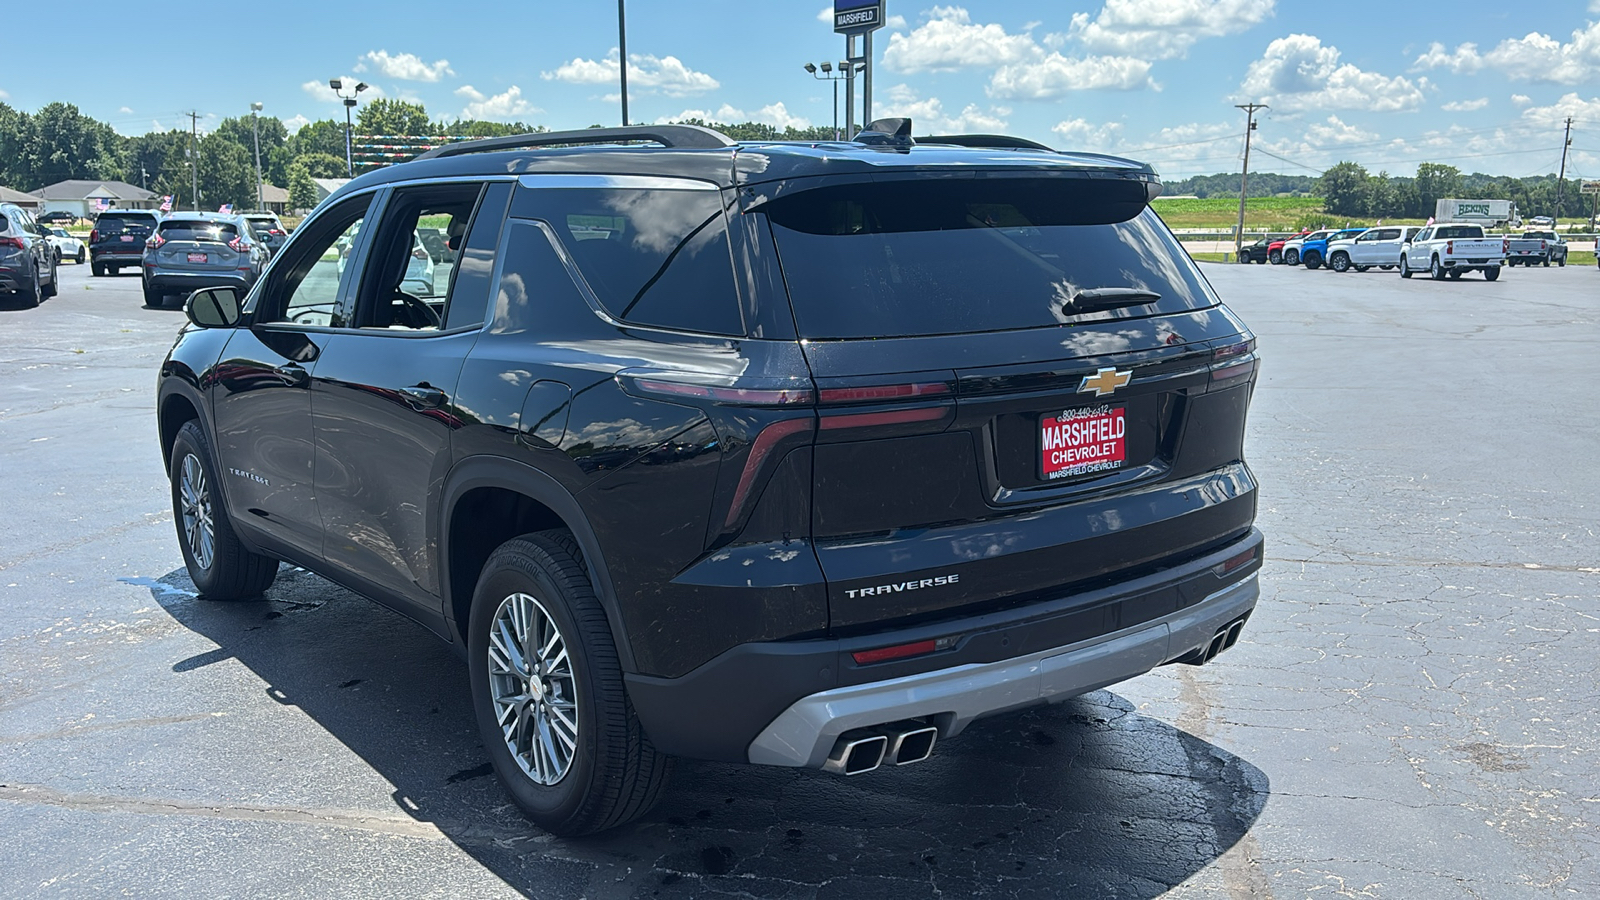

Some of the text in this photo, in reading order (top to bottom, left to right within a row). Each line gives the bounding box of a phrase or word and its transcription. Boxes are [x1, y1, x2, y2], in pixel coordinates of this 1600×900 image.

[838, 10, 873, 25] MARSHFIELD
[1458, 204, 1490, 216] BEKINS
[1042, 416, 1125, 451] MARSHFIELD
[1051, 442, 1117, 464] CHEVROLET
[1049, 459, 1122, 480] MARSHFIELD CHEVROLET
[845, 574, 959, 599] TRAVERSE
